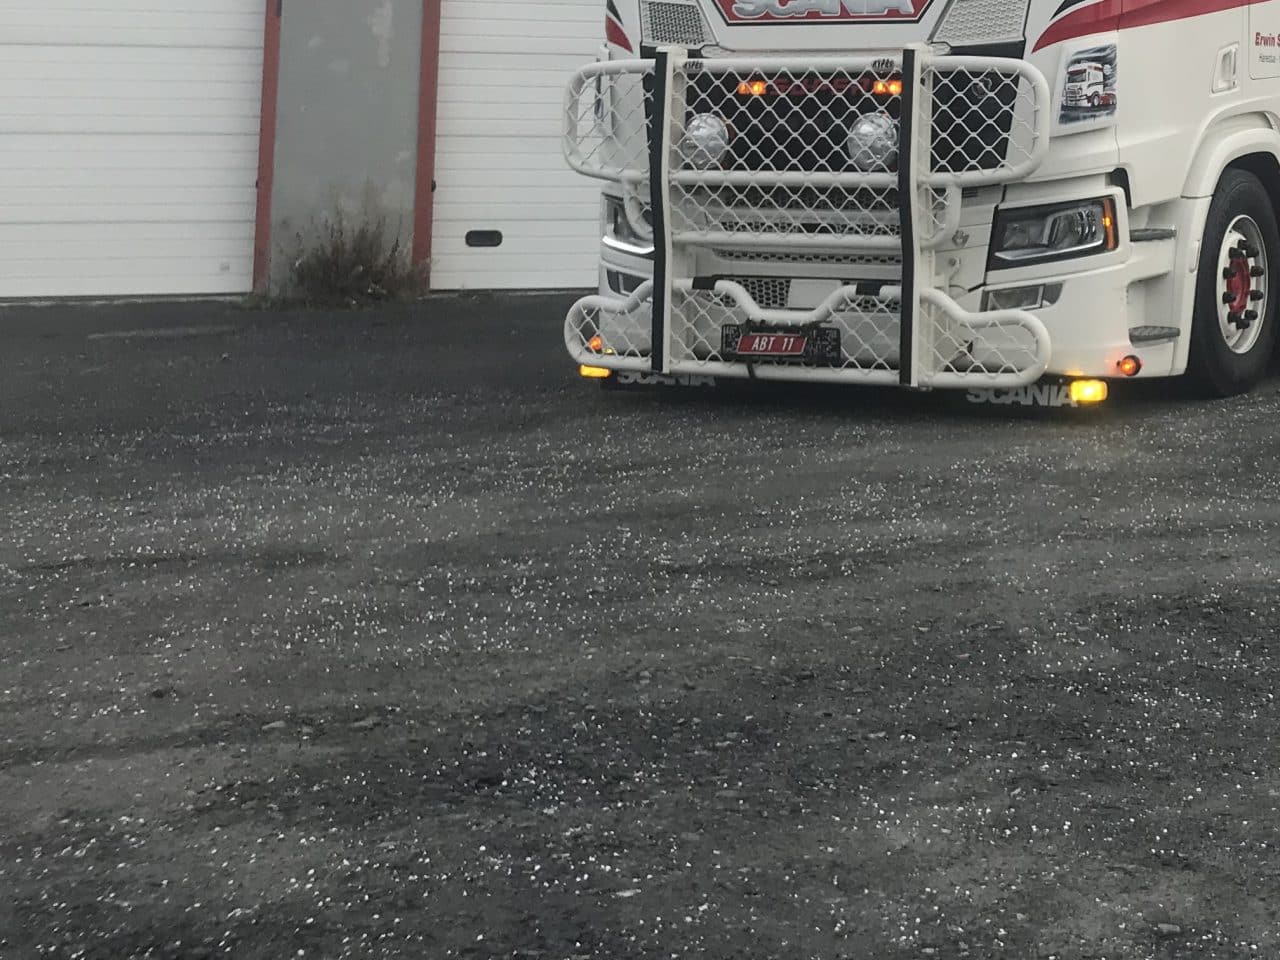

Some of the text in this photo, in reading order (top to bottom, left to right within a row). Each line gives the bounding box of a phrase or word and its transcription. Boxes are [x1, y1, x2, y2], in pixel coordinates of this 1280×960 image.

[1255, 32, 1276, 47] Erwin
[751, 336, 776, 351] ABT
[782, 338, 795, 351] 11
